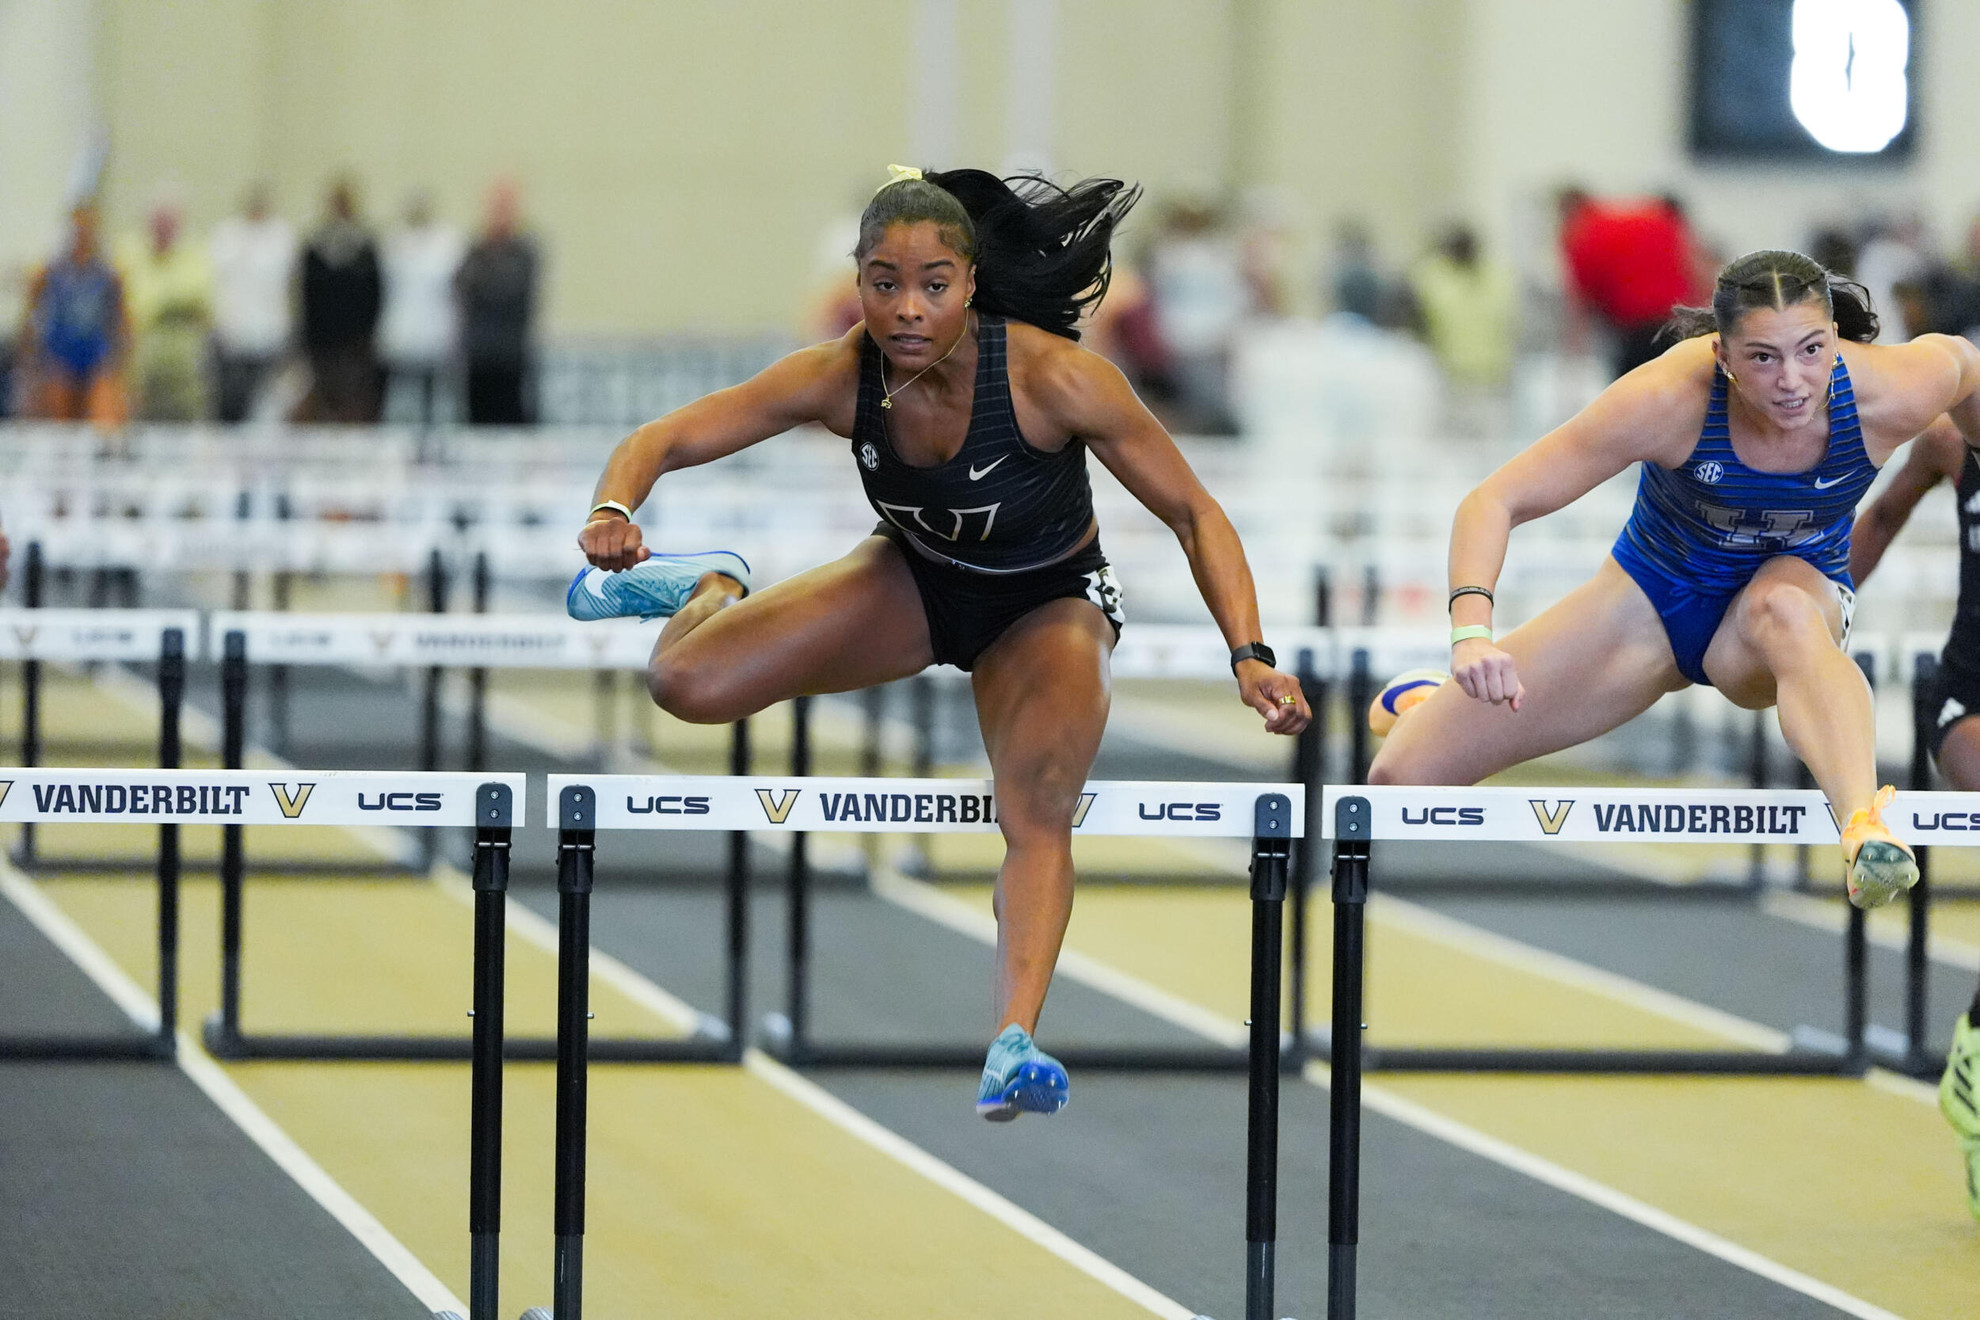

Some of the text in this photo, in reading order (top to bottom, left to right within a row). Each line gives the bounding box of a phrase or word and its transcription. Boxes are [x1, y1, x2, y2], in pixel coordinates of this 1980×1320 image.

[1697, 463, 1721, 483] SEC
[33, 785, 249, 814] VANDERBILT
[358, 793, 441, 810] UCS
[627, 796, 709, 814] UCS
[820, 794, 998, 823] VANDERBI
[1139, 803, 1220, 821] UCS
[1402, 808, 1484, 825] UCS
[1594, 805, 1806, 833] VANDERBILT
